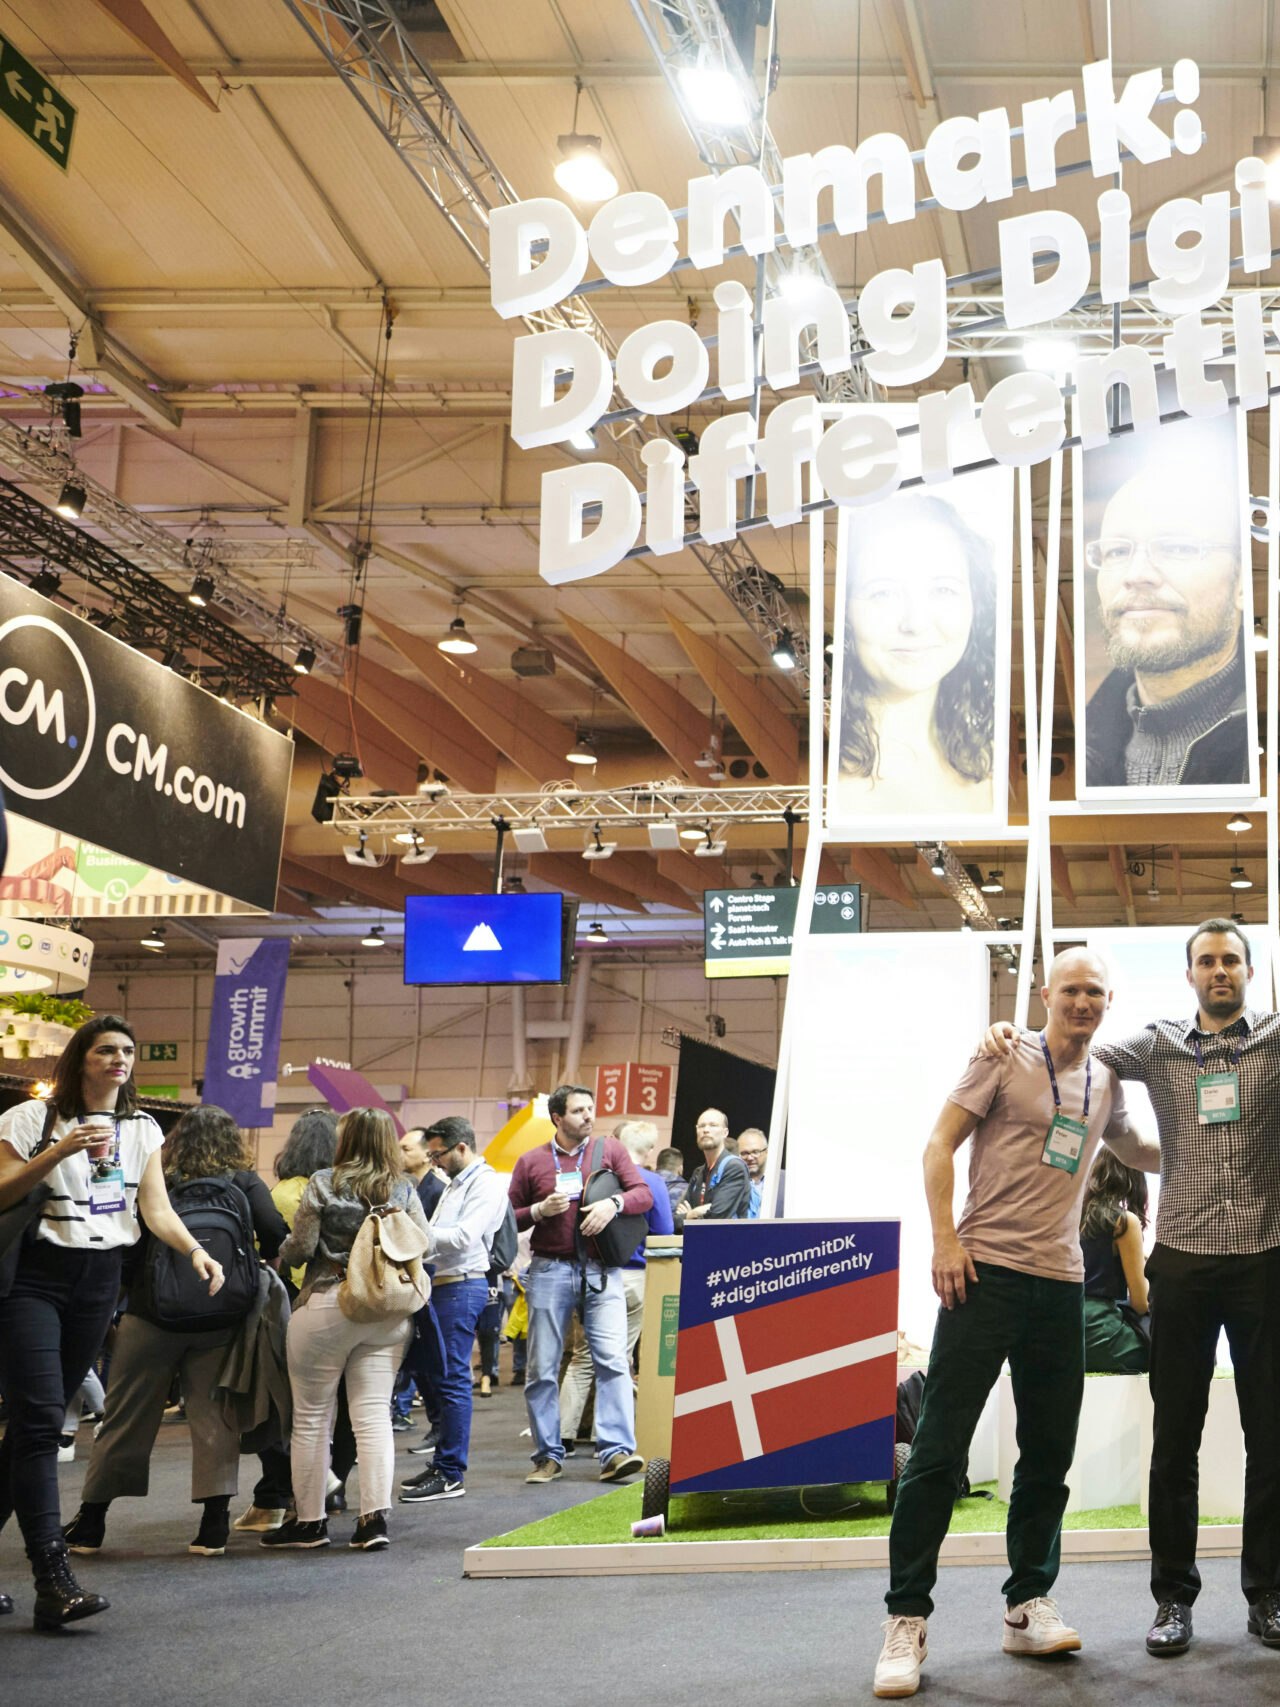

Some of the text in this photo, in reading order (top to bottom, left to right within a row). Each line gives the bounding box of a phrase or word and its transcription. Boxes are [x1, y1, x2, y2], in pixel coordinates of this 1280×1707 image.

[489, 57, 1201, 320] Denmark:
[511, 257, 949, 449] Doing
[106, 722, 246, 829] CM.com
[727, 893, 775, 904] Centre Stage
[727, 914, 753, 922] Forum
[746, 924, 779, 933] Monster
[771, 935, 788, 944] Talk
[228, 988, 249, 1061] growth
[247, 986, 268, 1060] summit
[604, 1086, 617, 1112] 3
[640, 1086, 657, 1111] 3
[706, 1234, 857, 1287] #WebSummitDK
[710, 1252, 873, 1308] #digitaldifferently
